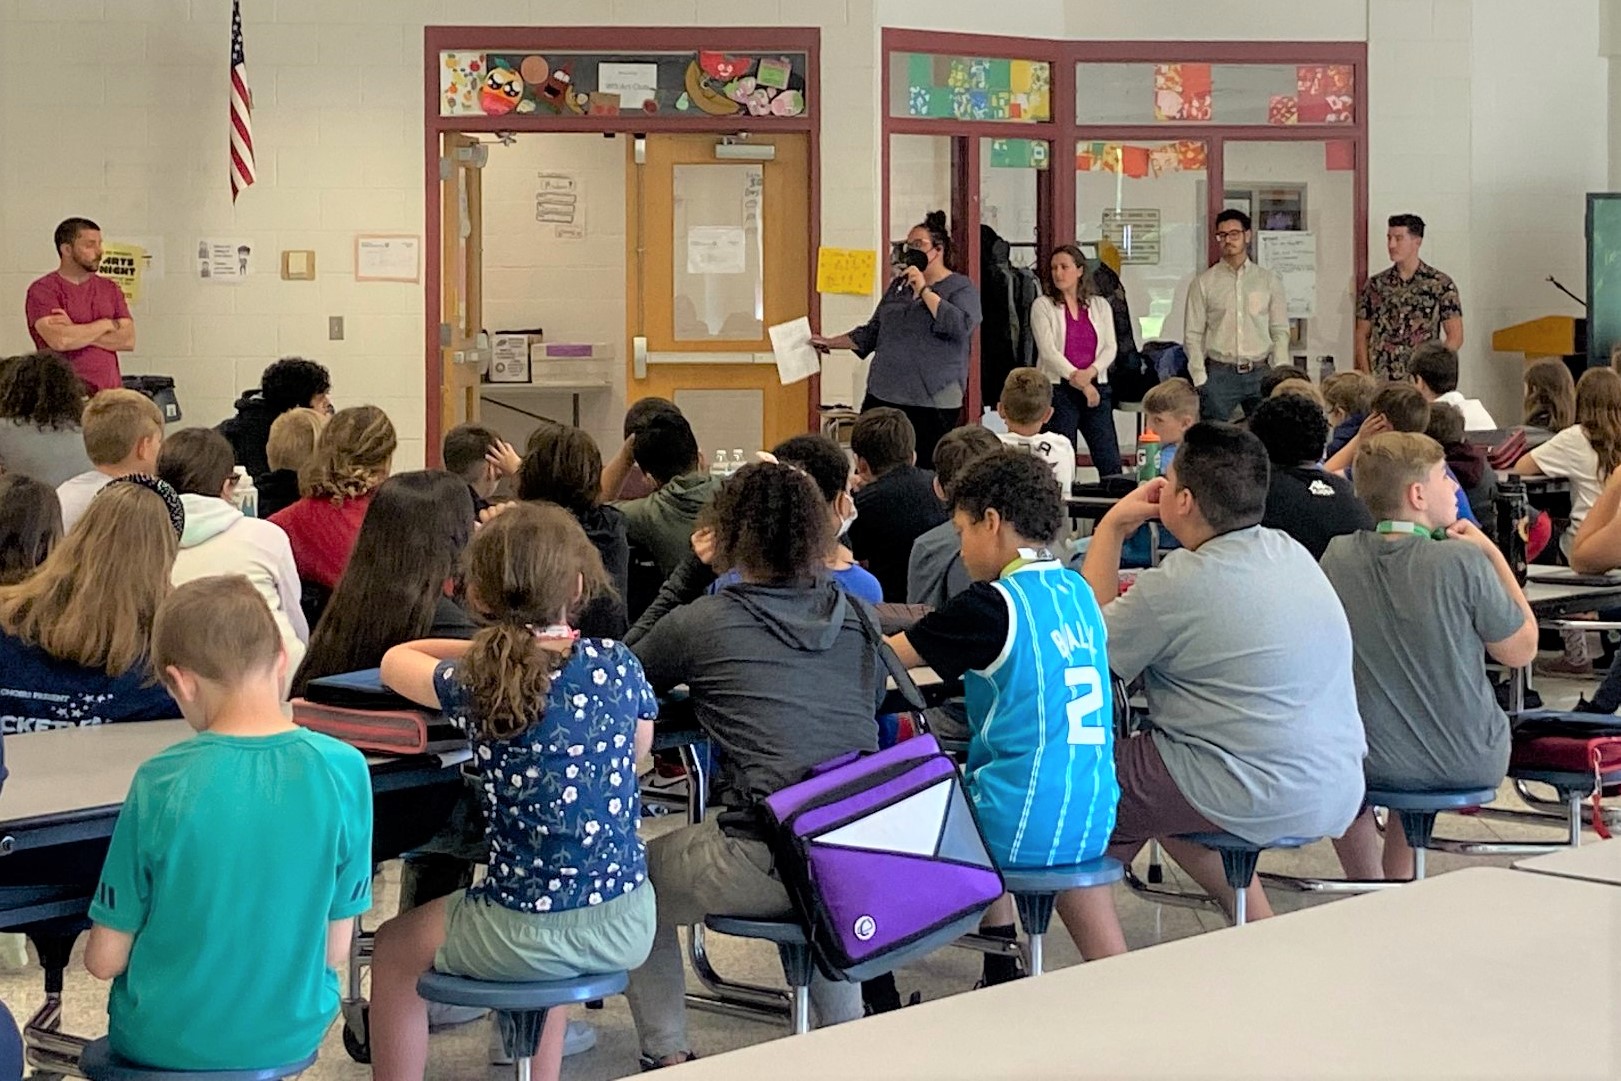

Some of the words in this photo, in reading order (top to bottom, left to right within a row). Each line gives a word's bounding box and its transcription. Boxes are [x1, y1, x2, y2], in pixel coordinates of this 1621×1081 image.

[103, 256, 134, 266] ARTS
[99, 265, 136, 276] NIGHT
[1137, 449, 1147, 466] G
[33, 691, 70, 703] PRESENT
[1064, 664, 1106, 745] 2
